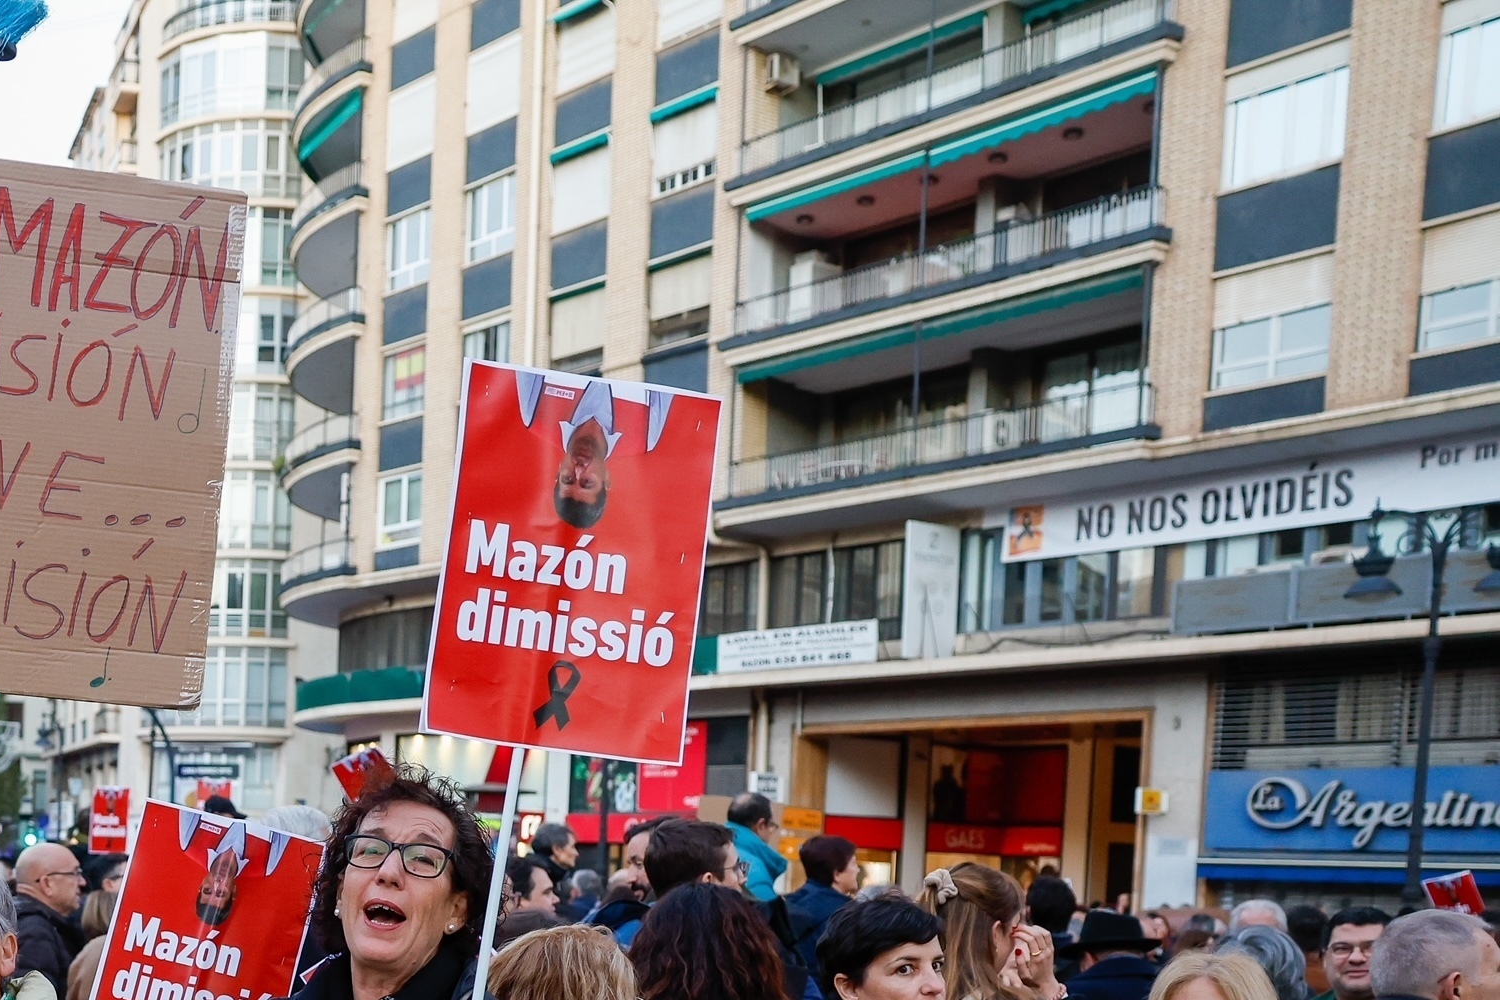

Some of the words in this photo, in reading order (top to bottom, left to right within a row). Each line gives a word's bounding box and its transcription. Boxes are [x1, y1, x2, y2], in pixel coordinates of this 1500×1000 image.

[1420, 443, 1461, 469] Por
[1076, 503, 1114, 541] NO
[1127, 493, 1187, 535] NOS
[1200, 462, 1355, 524] OLVIDÉIS
[464, 519, 627, 594] Mazón
[457, 588, 675, 667] dimissió
[944, 829, 986, 849] GAES
[1253, 784, 1282, 810] La
[1290, 778, 1500, 849] Argentin
[124, 912, 242, 977] Mazón
